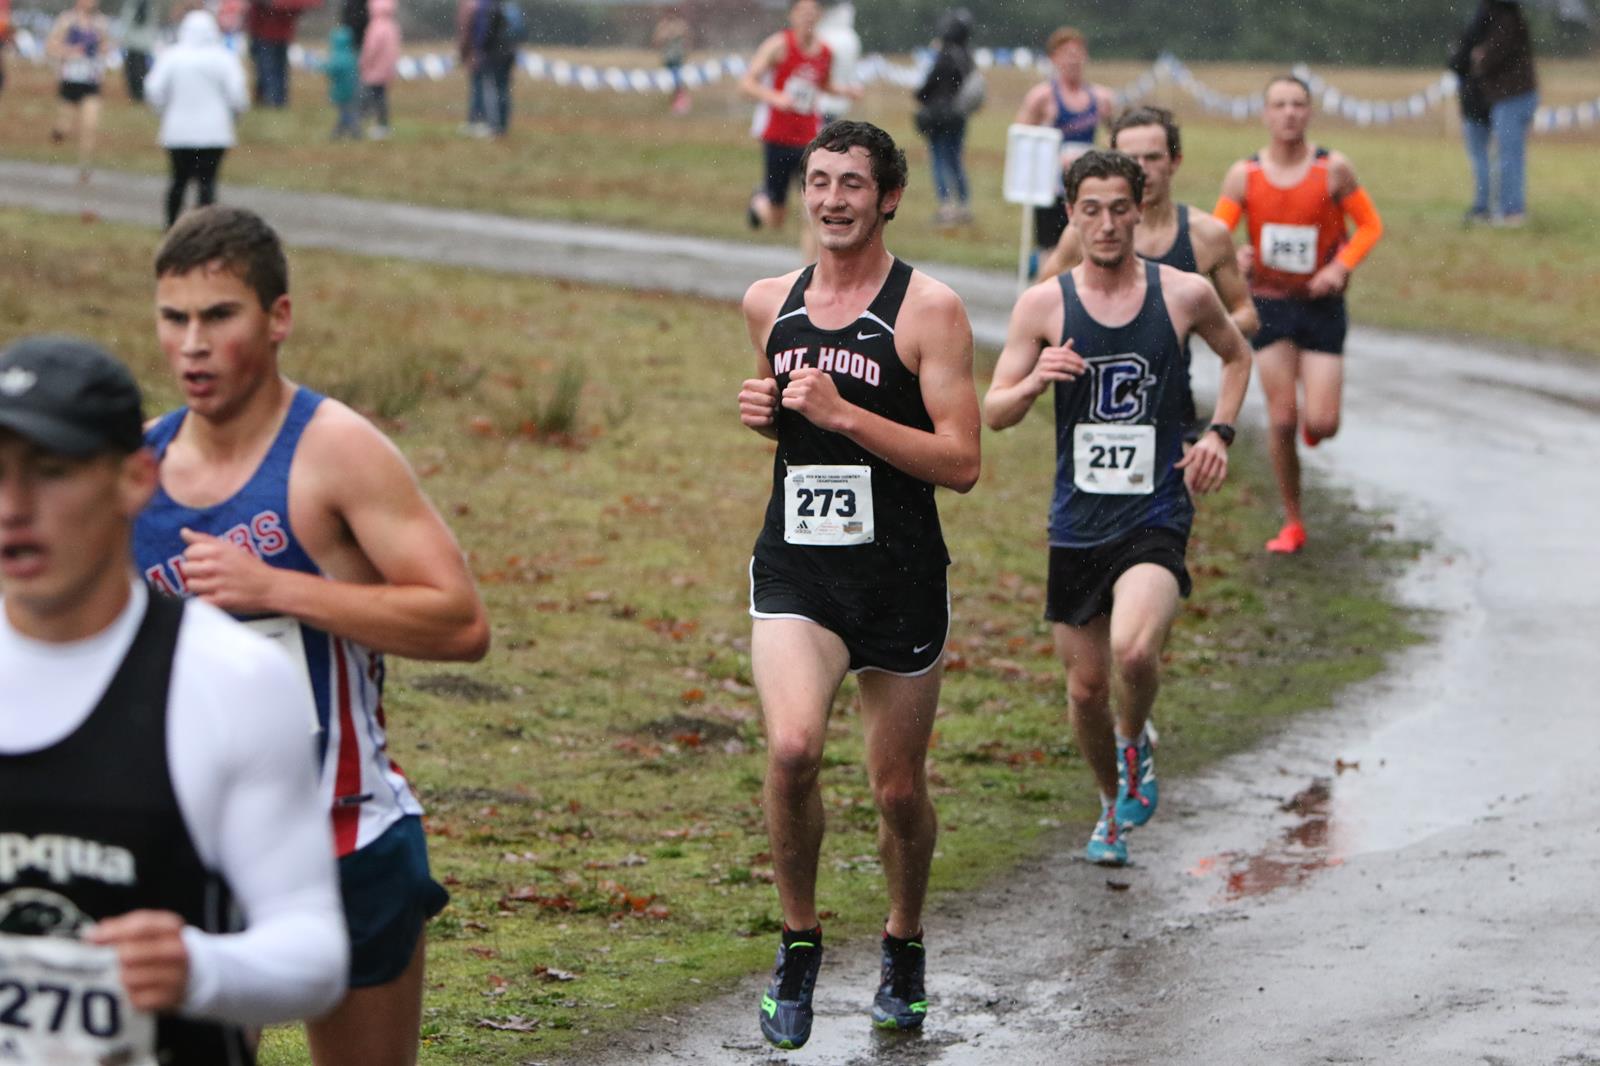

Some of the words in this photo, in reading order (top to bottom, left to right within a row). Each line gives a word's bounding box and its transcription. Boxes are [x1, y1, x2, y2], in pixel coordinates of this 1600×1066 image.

[774, 346, 810, 377] MT.
[818, 346, 881, 387] HOOD
[1089, 445, 1137, 469] 217
[796, 488, 857, 518] 273
[0, 979, 121, 1038] 270
